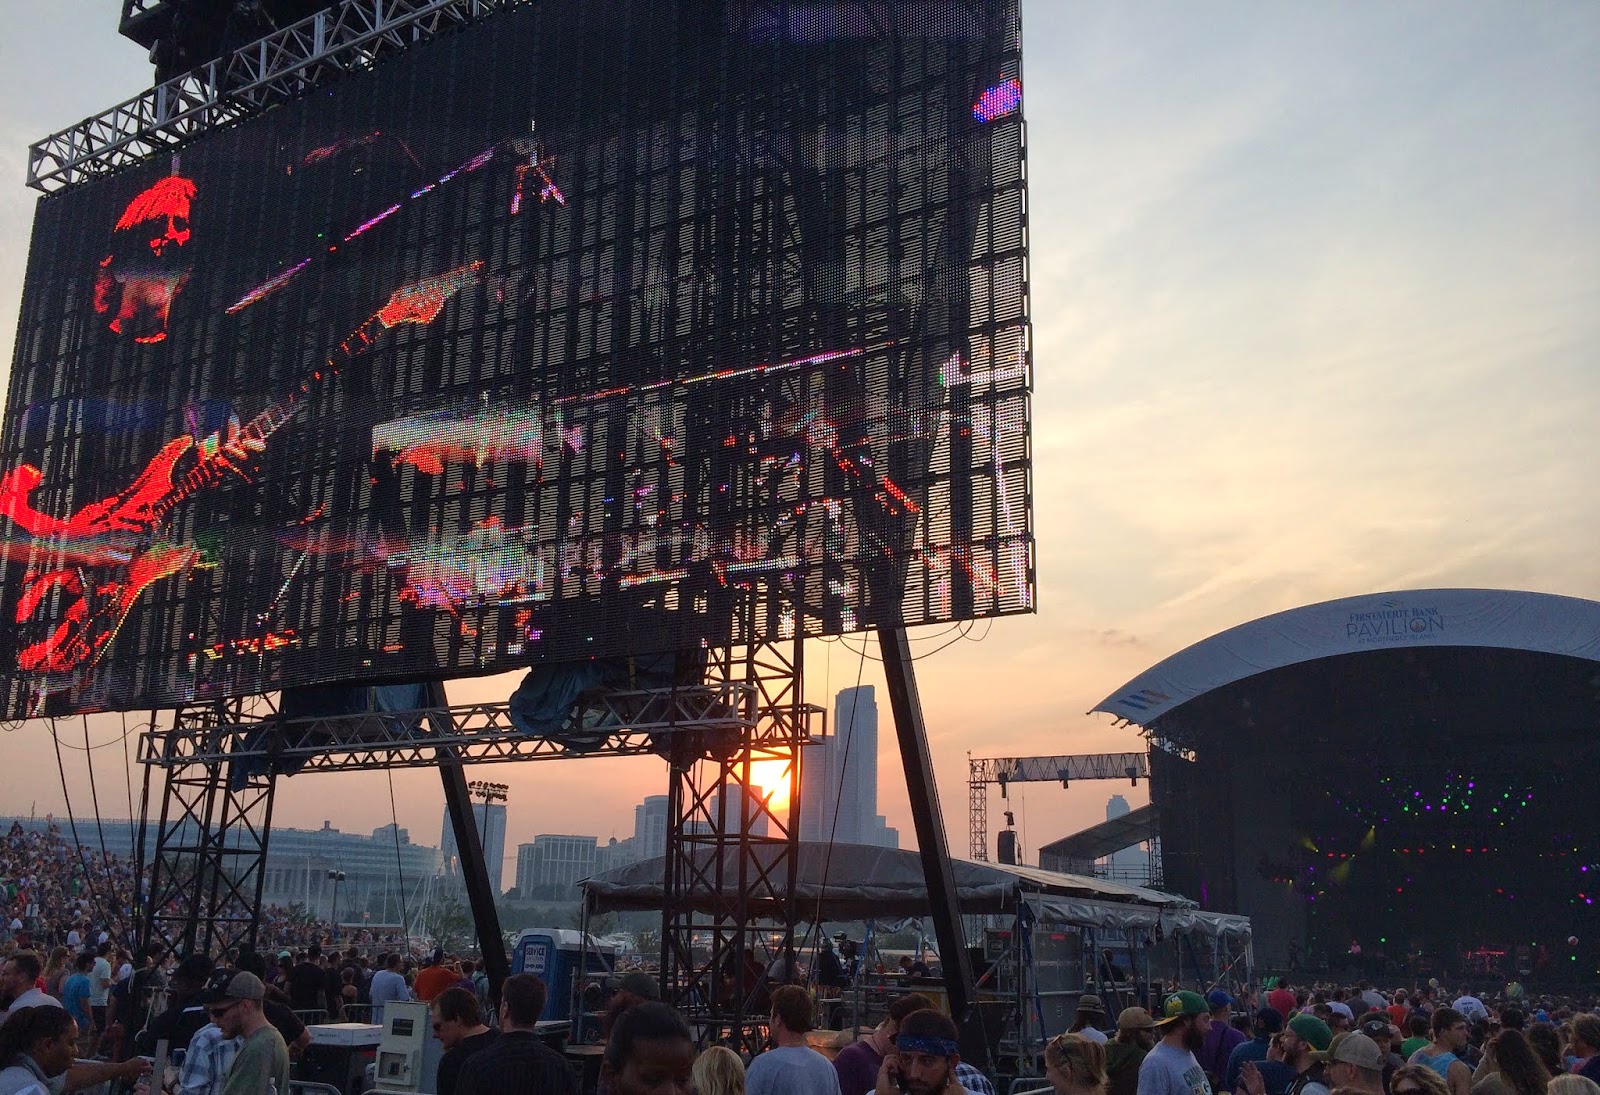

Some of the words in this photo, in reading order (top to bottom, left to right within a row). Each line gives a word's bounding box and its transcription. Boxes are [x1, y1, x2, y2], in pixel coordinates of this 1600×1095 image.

[1412, 607, 1439, 617] BANK
[1346, 614, 1445, 638] PAVILION
[526, 947, 545, 956] SERVICE
